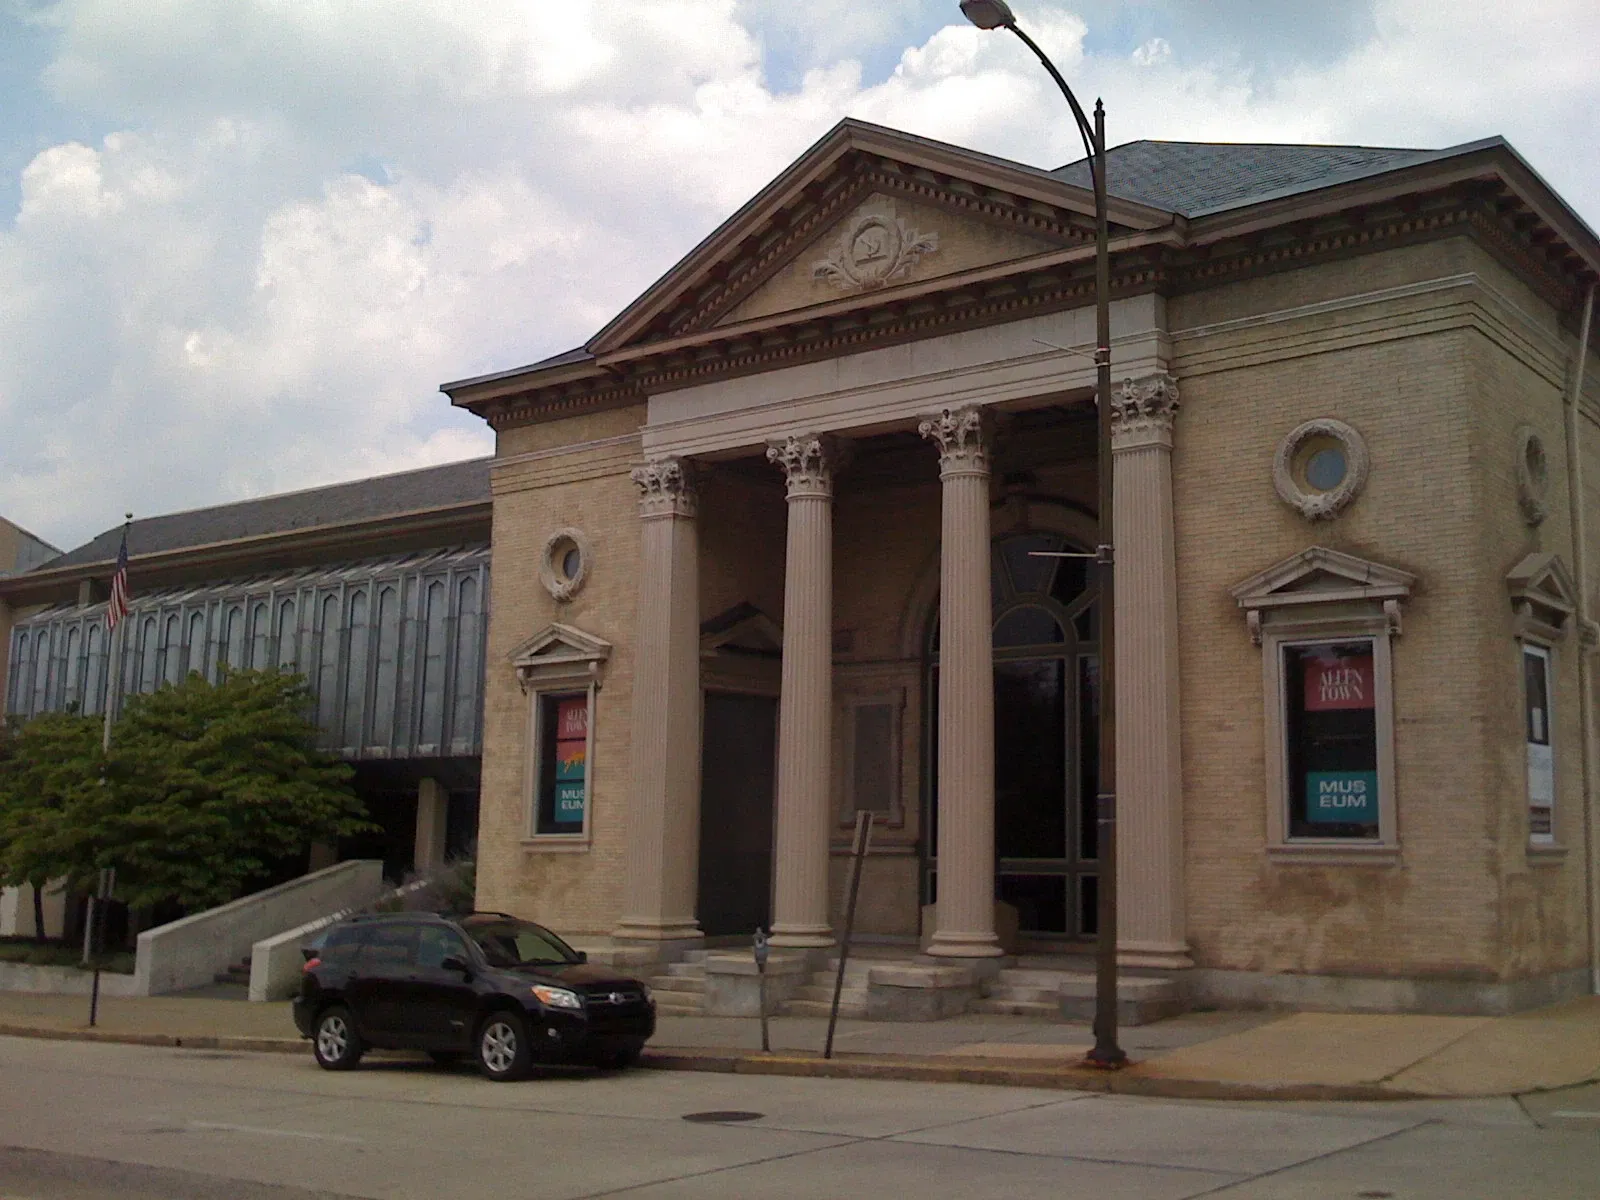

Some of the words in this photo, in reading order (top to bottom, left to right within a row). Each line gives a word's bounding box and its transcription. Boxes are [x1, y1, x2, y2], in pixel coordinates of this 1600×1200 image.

[1319, 685, 1363, 702] TOWN
[1320, 780, 1367, 793] MUS
[1320, 794, 1367, 807] EUM
